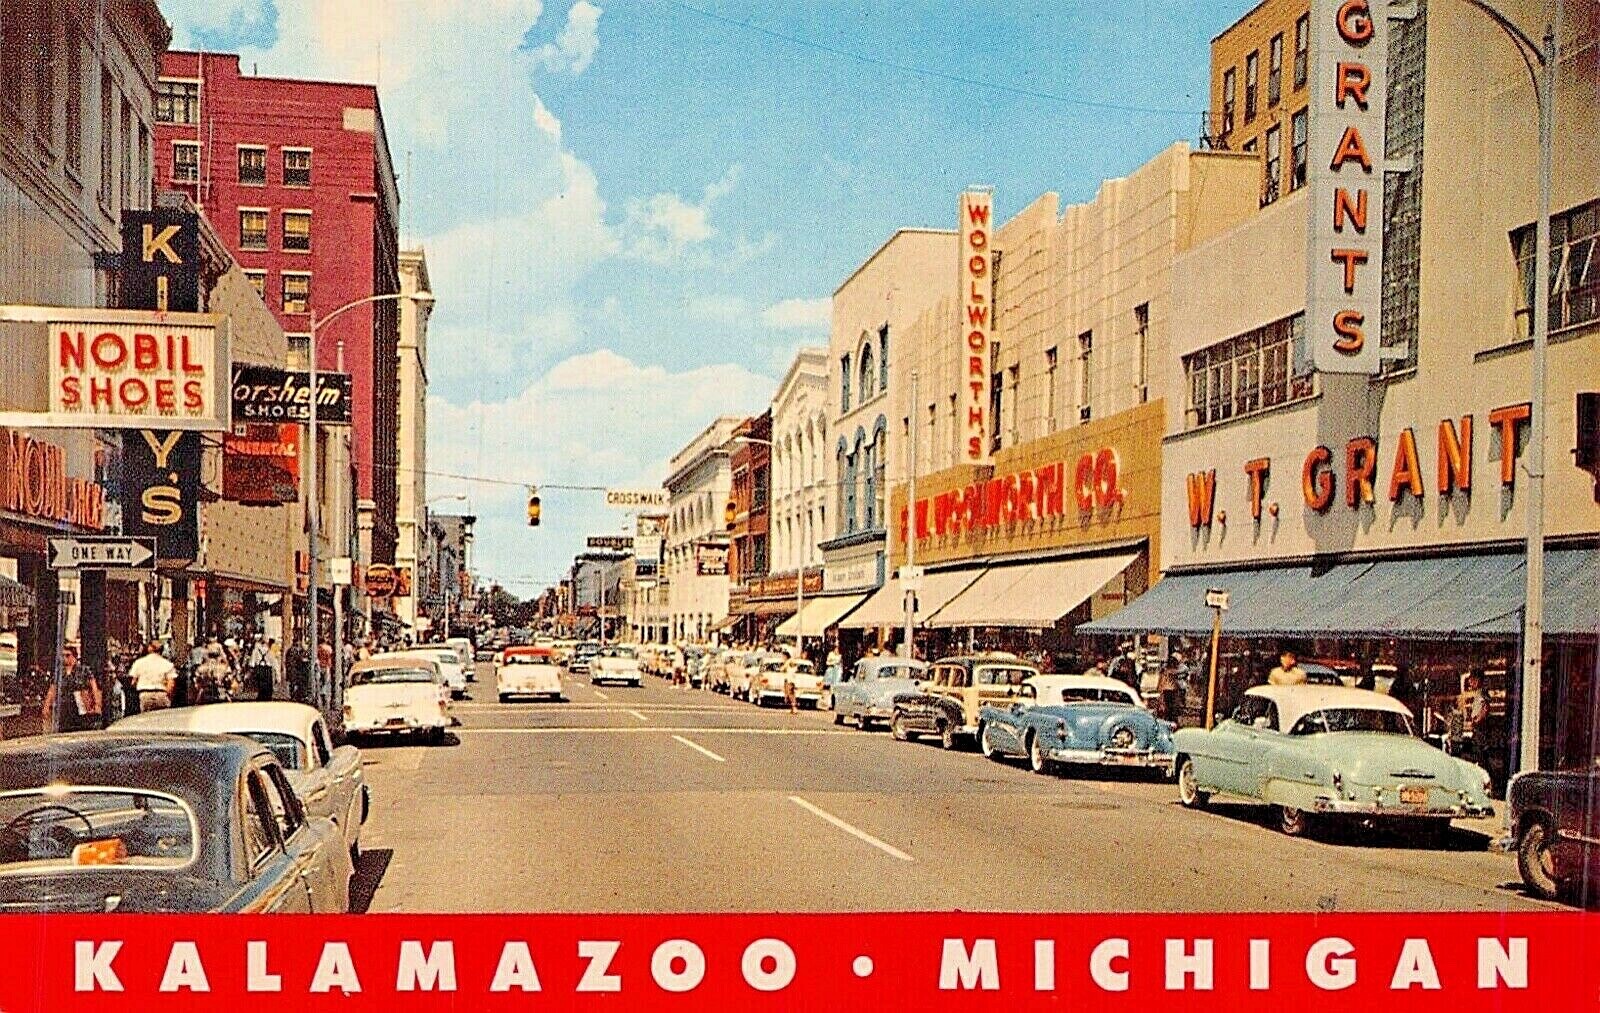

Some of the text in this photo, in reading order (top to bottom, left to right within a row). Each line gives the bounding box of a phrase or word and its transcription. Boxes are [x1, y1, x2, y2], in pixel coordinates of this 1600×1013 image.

[1330, 0, 1374, 354] GRANTS
[967, 204, 989, 459] WOOLWORTH'S
[60, 331, 203, 372] NOBIL
[61, 376, 204, 408] SHOES
[244, 404, 311, 419] SHOES
[1186, 402, 1532, 528] W. T. GRANT
[606, 491, 665, 505] CROSSWALK
[71, 546, 133, 560] ONE WAY
